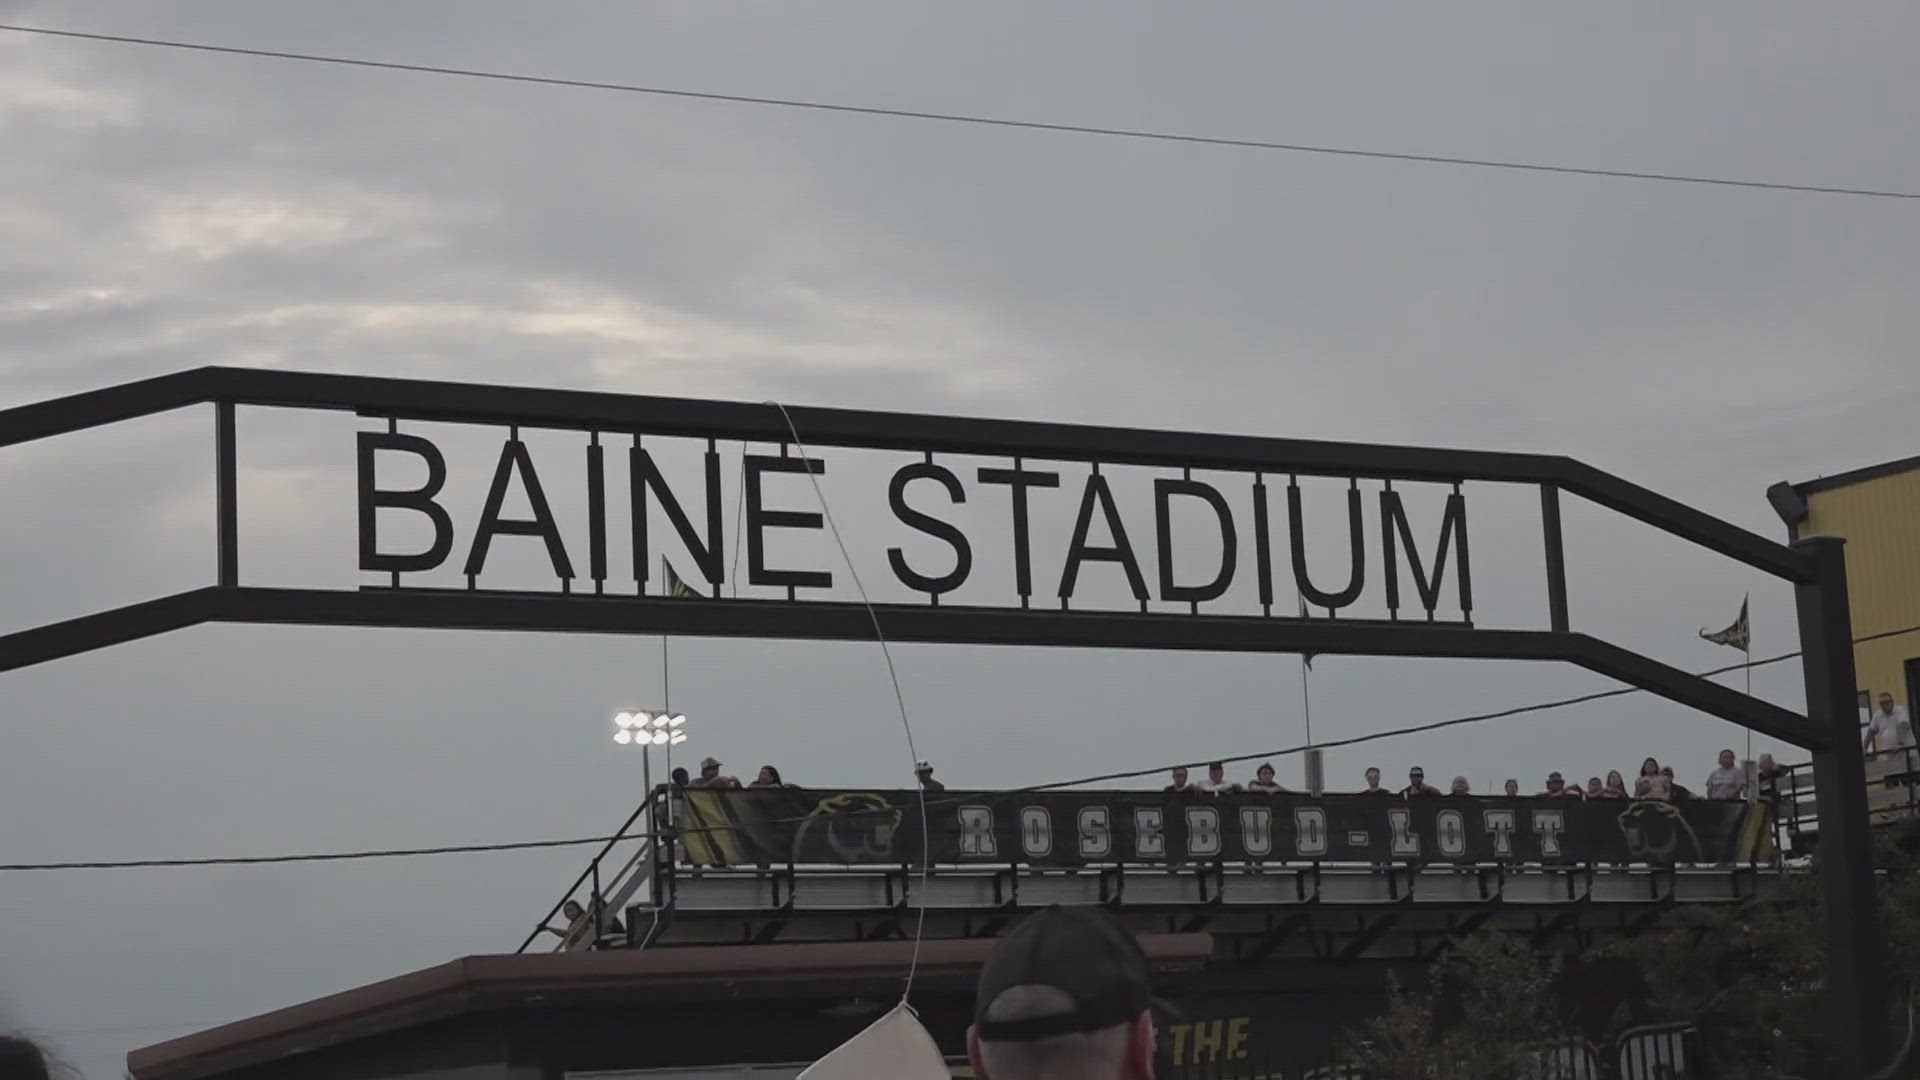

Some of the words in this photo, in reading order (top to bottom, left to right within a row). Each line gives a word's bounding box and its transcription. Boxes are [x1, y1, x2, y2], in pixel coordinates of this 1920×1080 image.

[357, 431, 833, 588] BAINE
[886, 462, 1474, 612] STADIUM
[1169, 1016, 1249, 1065] THE
